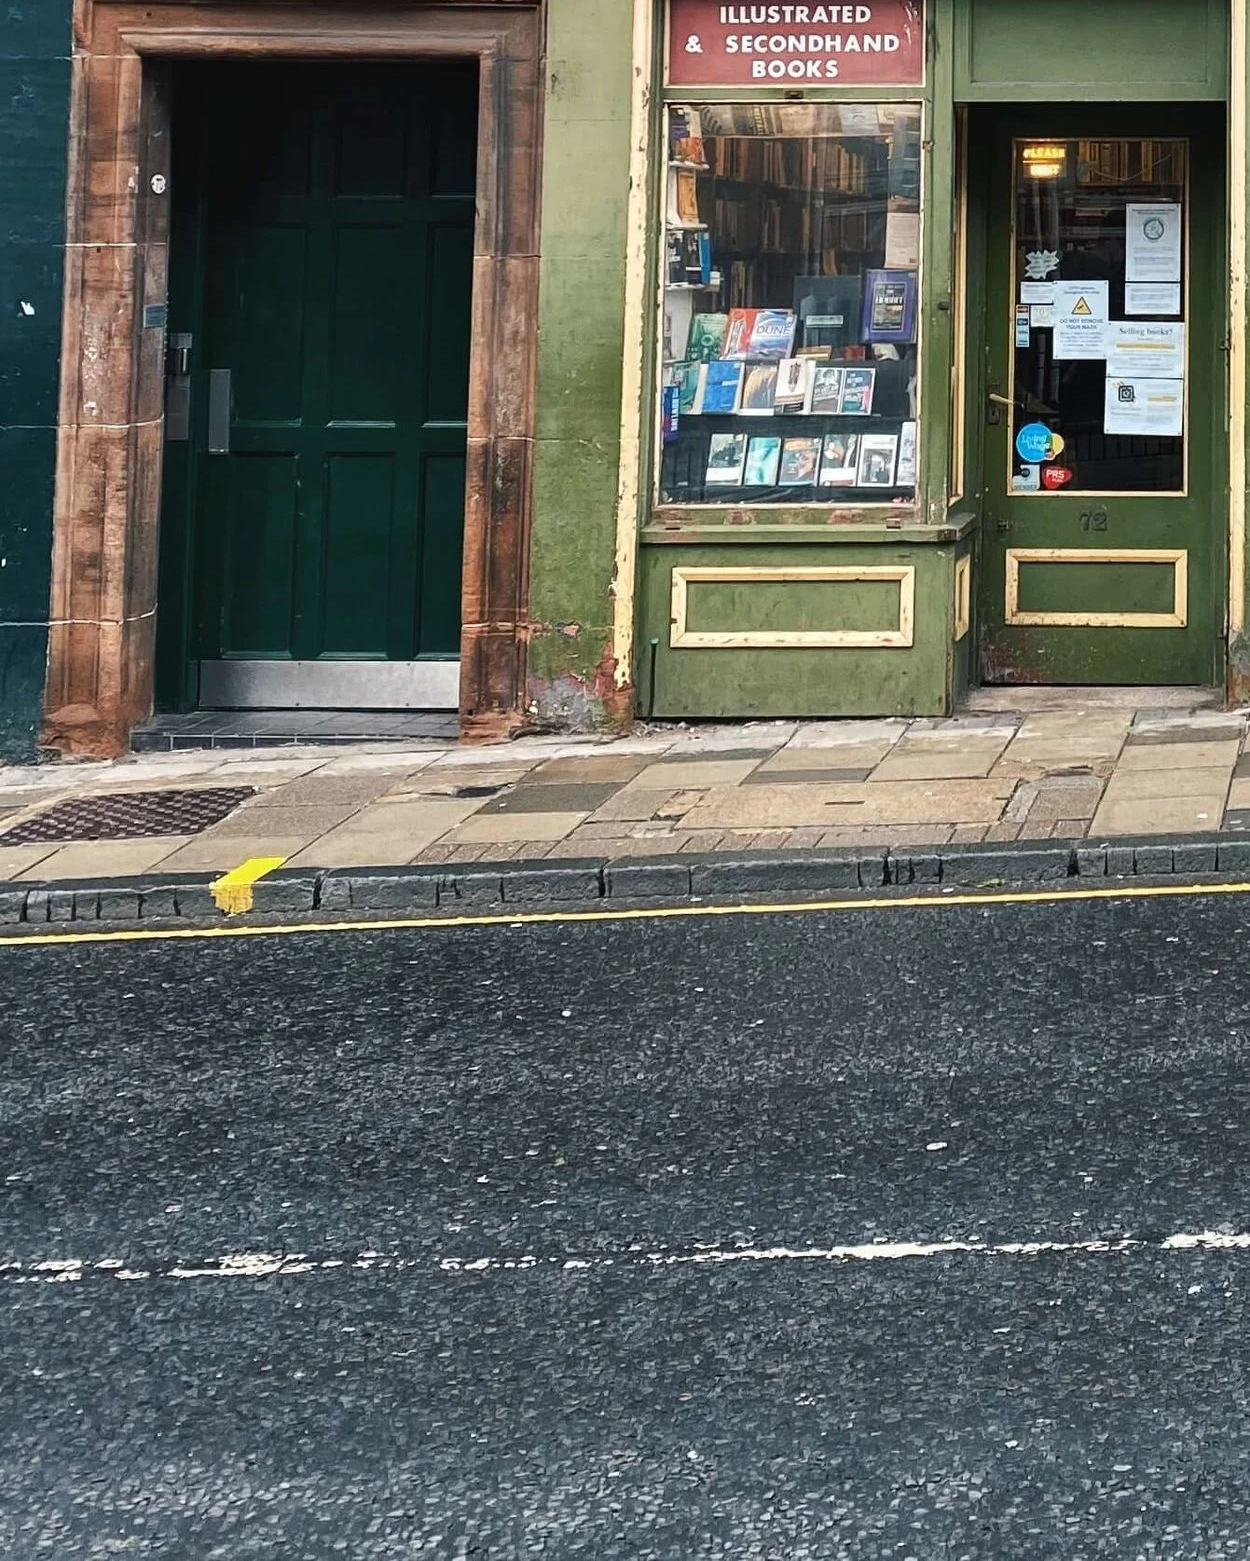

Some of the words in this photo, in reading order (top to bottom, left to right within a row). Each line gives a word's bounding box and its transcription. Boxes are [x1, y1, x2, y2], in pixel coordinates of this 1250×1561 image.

[719, 5, 872, 24] ILLUSTRATED
[685, 35, 704, 54] &
[725, 34, 900, 54] SECONDHAND
[752, 59, 839, 78] BOOKS
[756, 325, 792, 335] DUNE
[1119, 327, 1145, 336] Selling
[1045, 469, 1065, 479] PRS
[1079, 510, 1108, 532] 72
